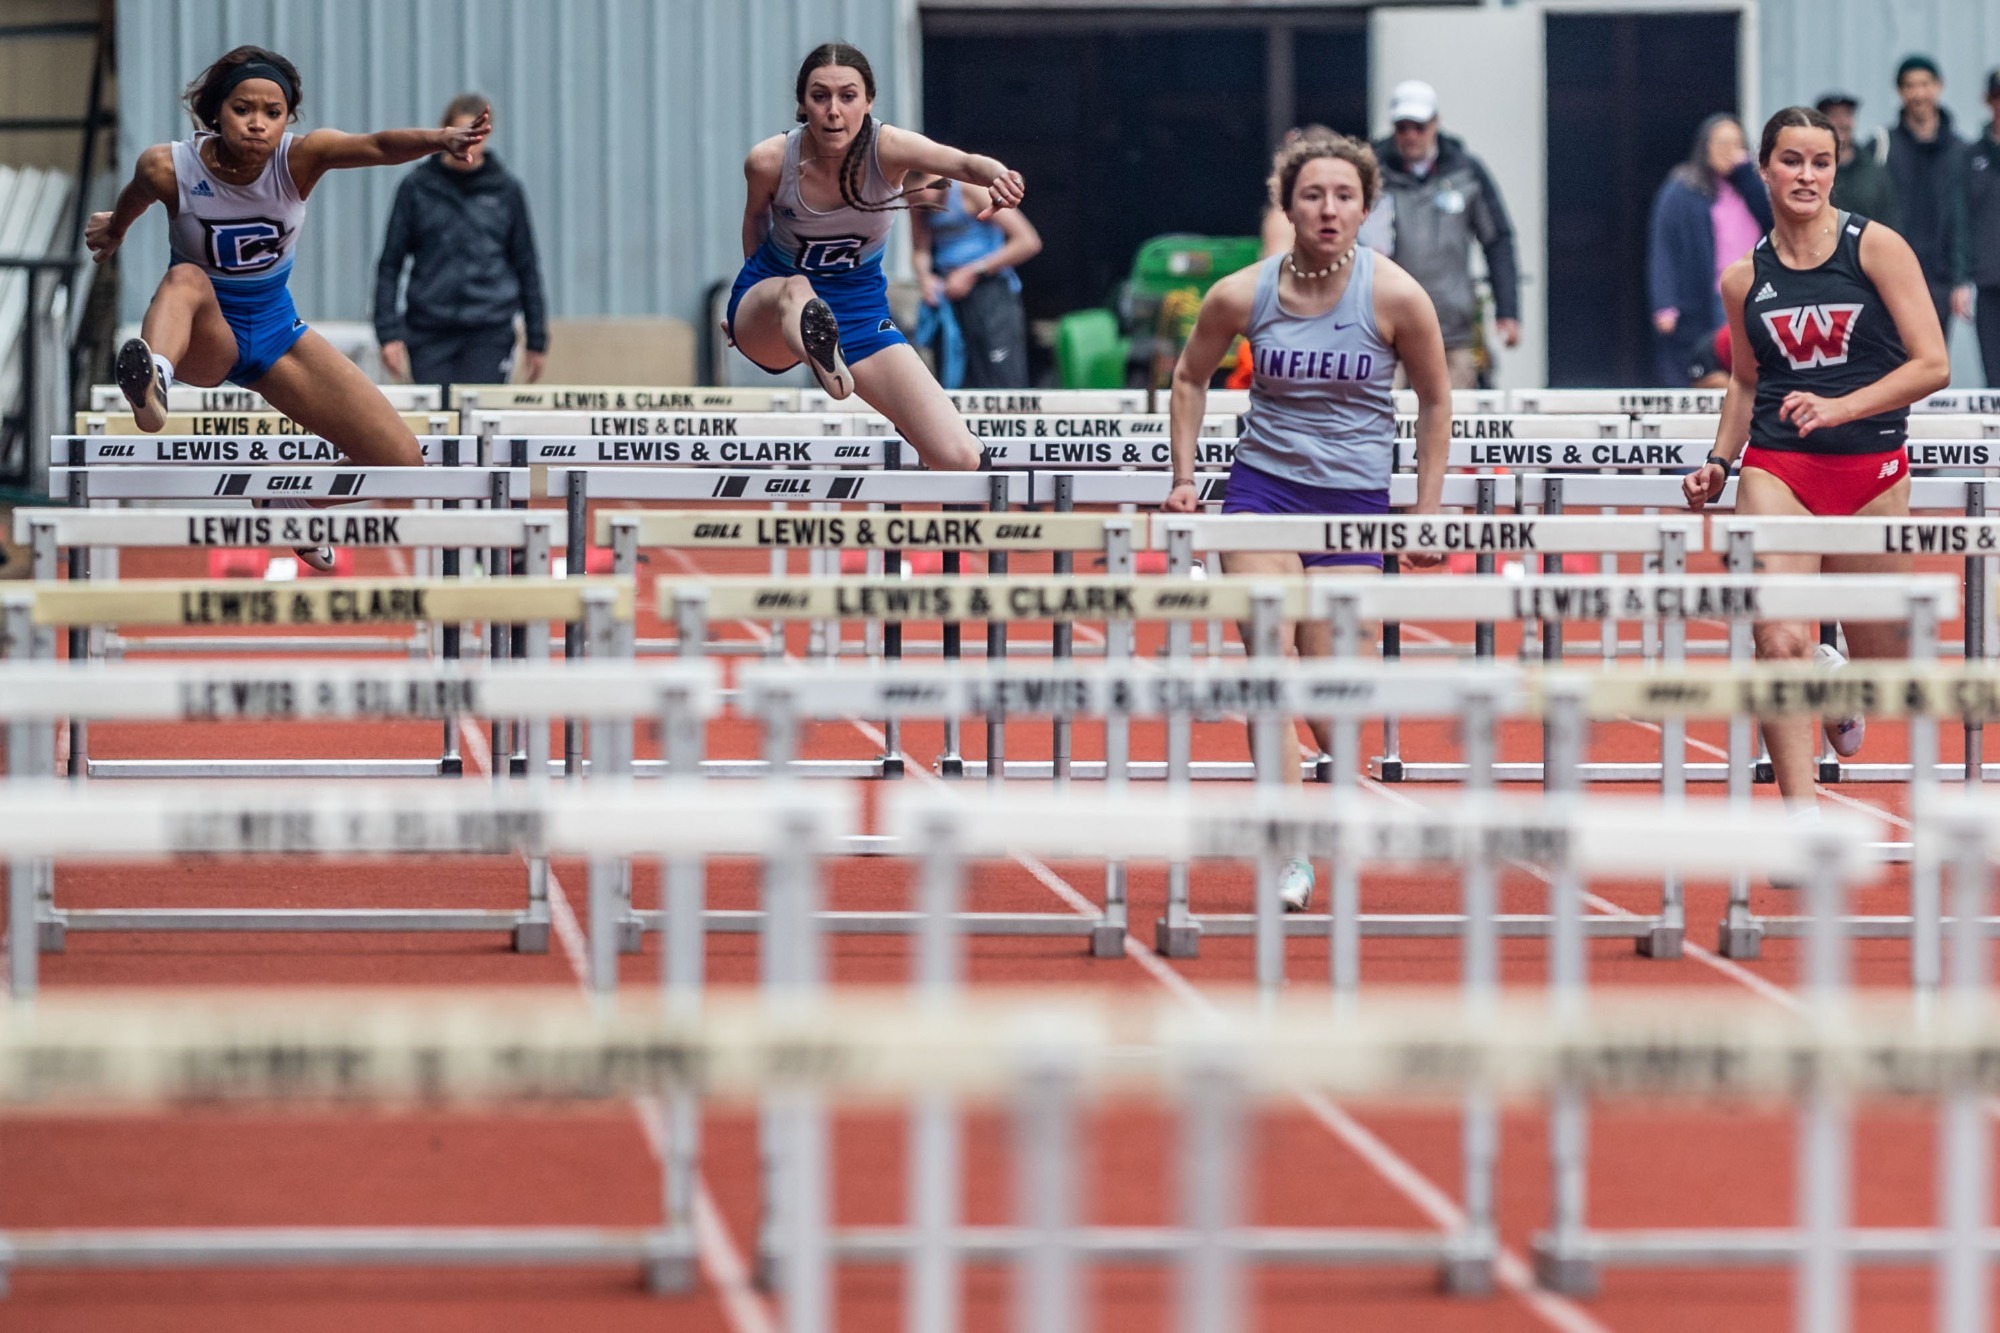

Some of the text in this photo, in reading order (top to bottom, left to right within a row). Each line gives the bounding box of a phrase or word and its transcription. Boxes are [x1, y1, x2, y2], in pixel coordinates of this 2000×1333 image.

[1760, 303, 1864, 371] W
[1252, 347, 1373, 381] INFIELD
[203, 392, 255, 410] LEWIS
[553, 392, 609, 409] LEWIS
[616, 392, 626, 409] &
[635, 392, 694, 409] CLARK
[983, 396, 1043, 412] CLARK
[193, 417, 249, 435] LEWIS
[256, 418, 272, 435] &
[591, 417, 738, 436] LEWIS & CLARK
[967, 419, 1027, 437] LEWIS
[1034, 420, 1048, 437] &
[1055, 419, 1122, 437] CLARK
[1451, 420, 1514, 438] CLARK
[98, 445, 136, 457] GILL
[157, 441, 239, 461] LEWIS
[249, 441, 269, 461] &
[540, 442, 871, 462] GILL LEWIS & CLARK GILL
[1029, 443, 1111, 463] LEWIS
[1122, 443, 1142, 463] &
[1470, 444, 1684, 464] LEWIS & CLARK
[1907, 445, 1989, 465] LEWIS
[266, 476, 313, 490] GILL
[764, 479, 812, 493] GILL
[188, 516, 400, 544] LEWIS & CLARK
[693, 518, 1043, 545] GILL LEWIS & CLARK GILL
[1324, 522, 1536, 549] LEWIS & CLARK
[1885, 525, 1996, 553] LEWIS &
[182, 589, 278, 623] LEWIS
[328, 589, 429, 623] CLARK
[835, 586, 952, 615] LEWIS
[969, 587, 991, 614] &
[1009, 586, 1136, 616] CLARK
[1513, 587, 1610, 618] LEWIS
[1655, 587, 1760, 618] CLARK
